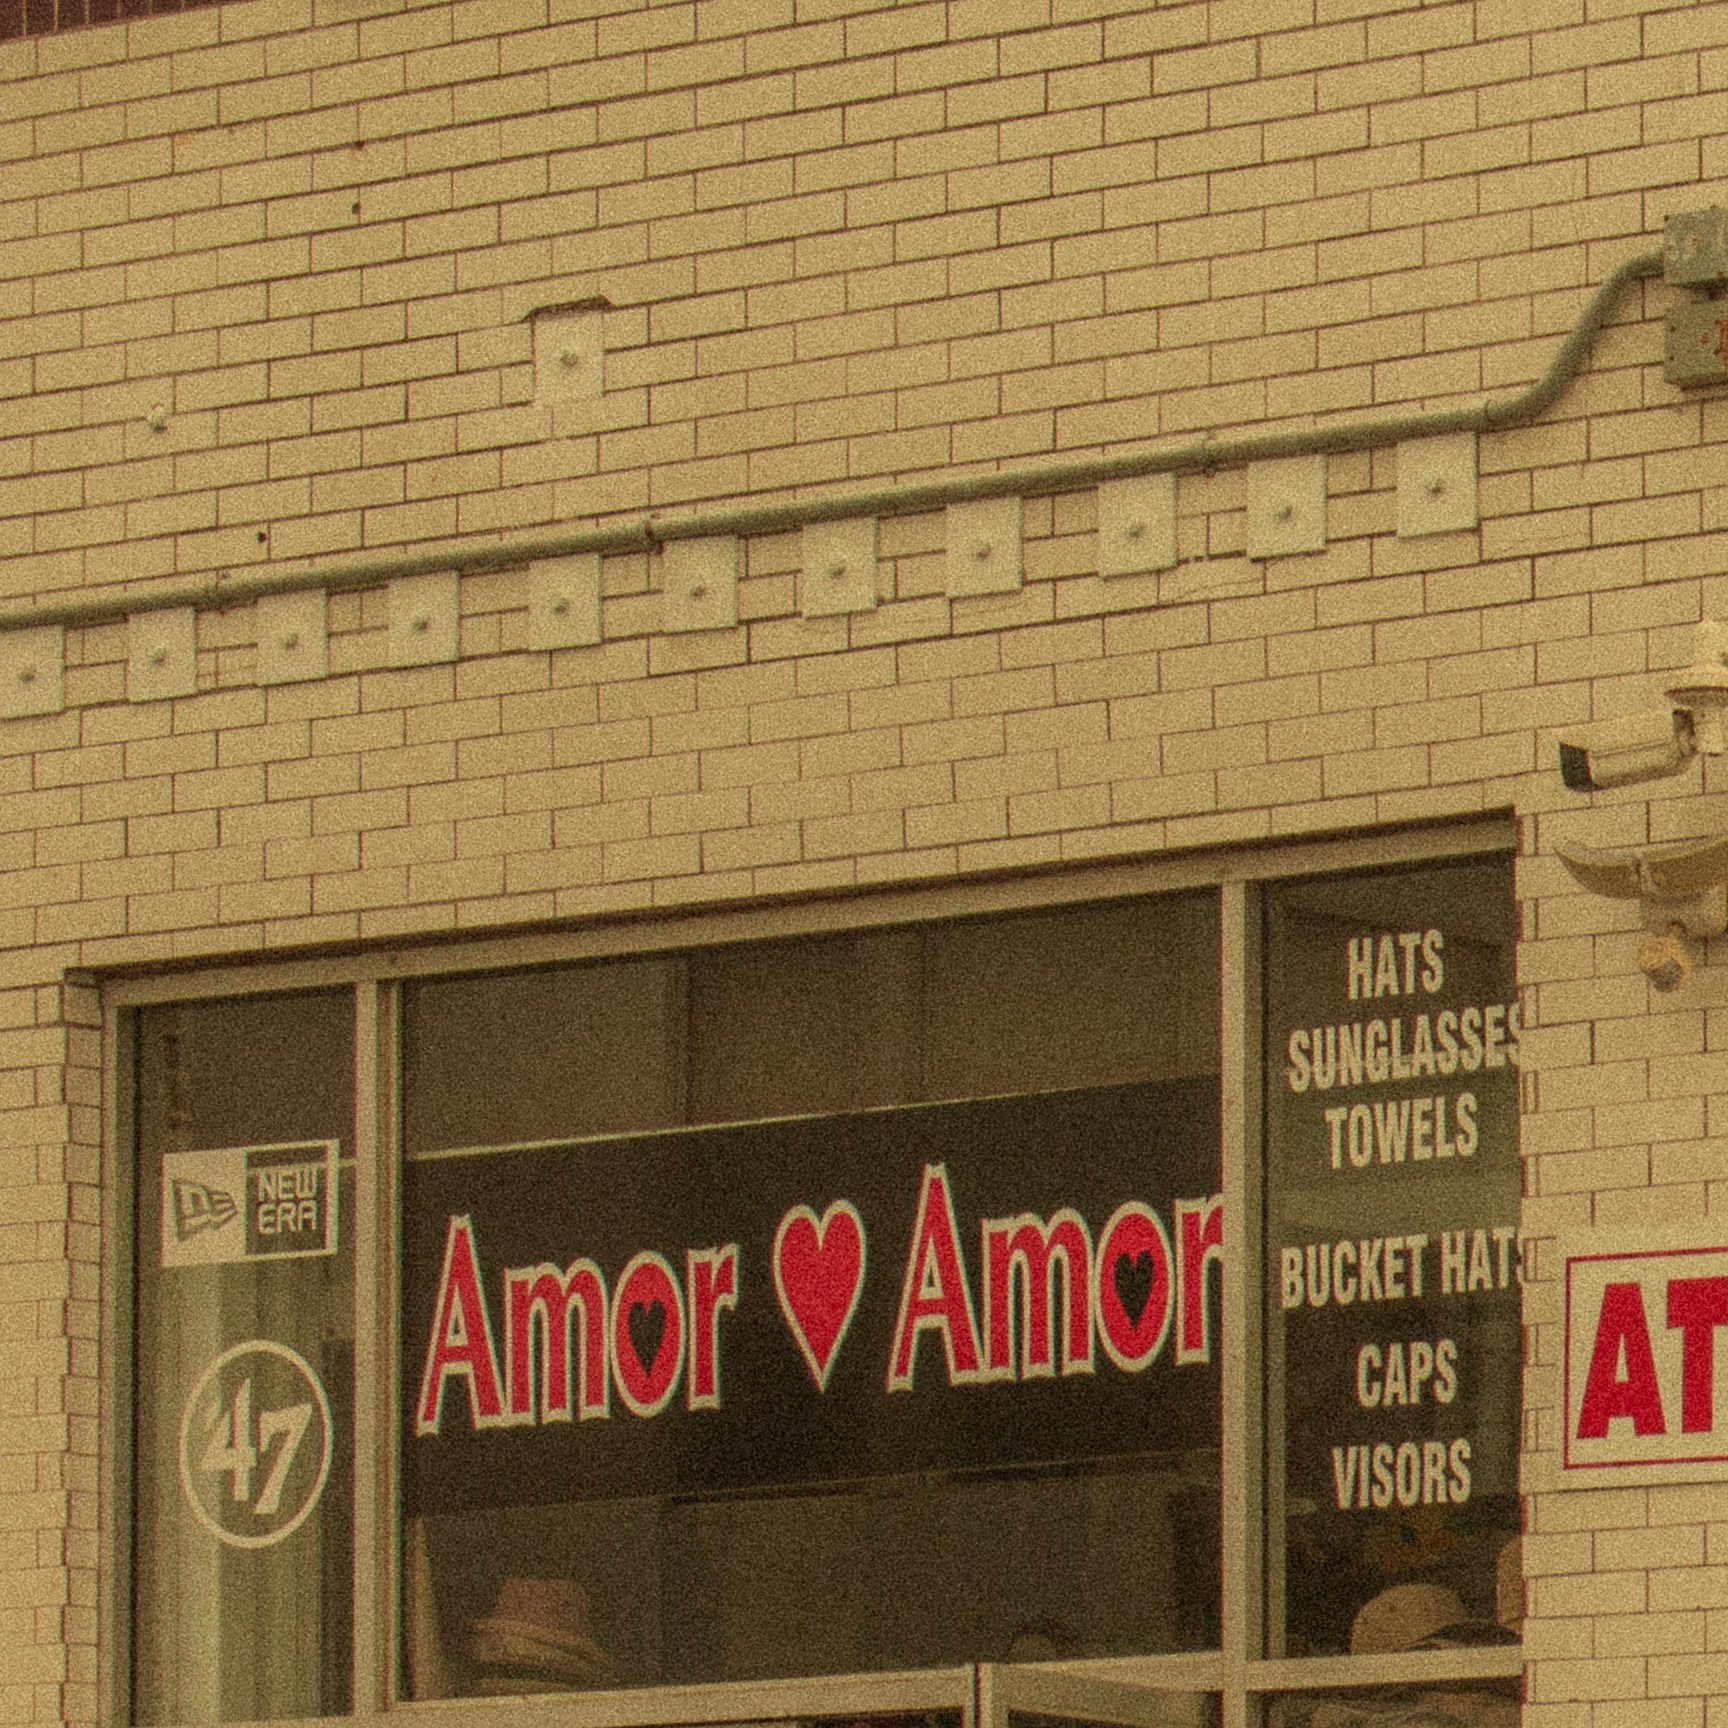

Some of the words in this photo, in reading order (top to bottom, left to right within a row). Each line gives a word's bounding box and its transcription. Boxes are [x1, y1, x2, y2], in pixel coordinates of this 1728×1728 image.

[1347, 929, 1445, 1000] HATS
[1325, 1092, 1479, 1169] TOWELS
[258, 1166, 318, 1202] NEW
[258, 1201, 318, 1235] ERA
[416, 1213, 740, 1437] Amor
[886, 1161, 1223, 1392] Amor
[1281, 1232, 1428, 1309] BUCKET
[1356, 1339, 1458, 1408] CAPS
[1333, 1437, 1472, 1510] VISORS
